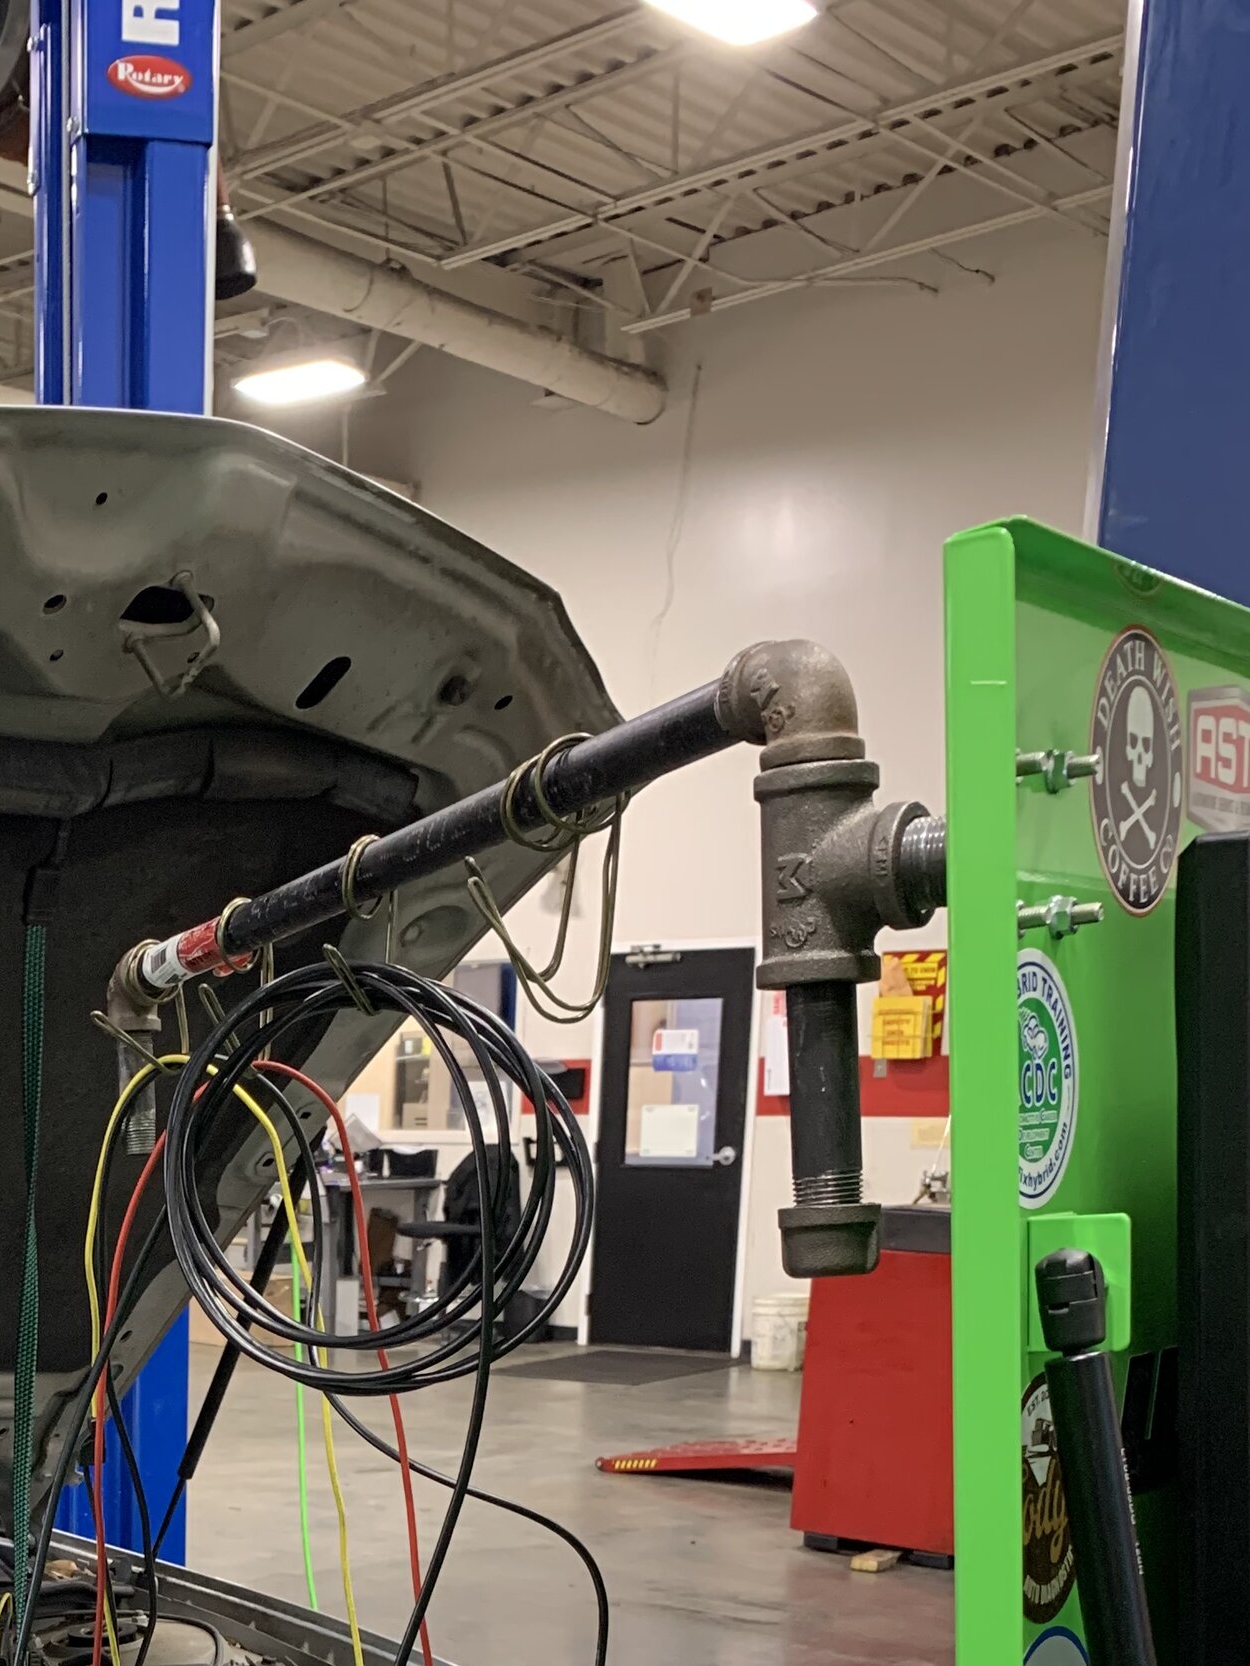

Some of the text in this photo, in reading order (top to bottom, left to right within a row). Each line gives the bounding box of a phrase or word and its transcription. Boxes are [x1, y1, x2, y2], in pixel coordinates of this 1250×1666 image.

[116, 61, 184, 94] Rotary
[1097, 640, 1181, 752] DEATH WISH
[1099, 818, 1159, 904] COFFEE
[1041, 977, 1072, 1080] TRAINING
